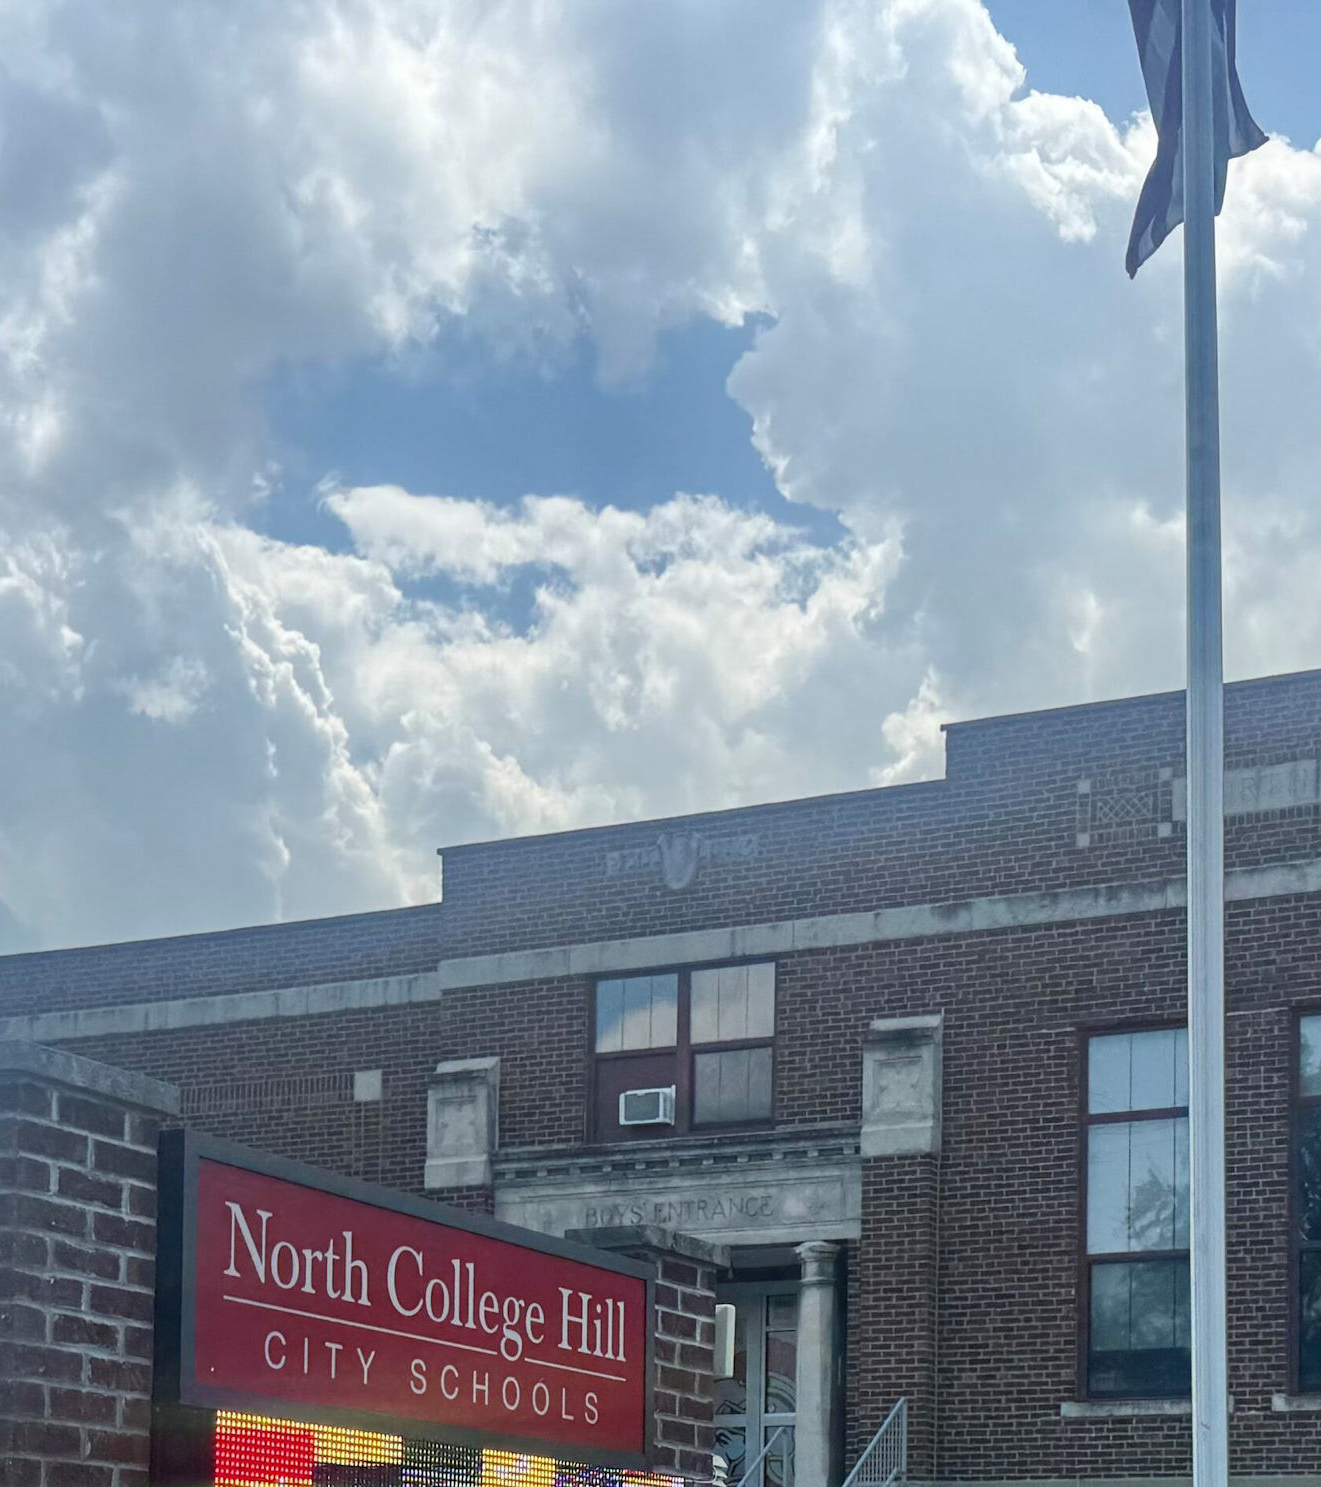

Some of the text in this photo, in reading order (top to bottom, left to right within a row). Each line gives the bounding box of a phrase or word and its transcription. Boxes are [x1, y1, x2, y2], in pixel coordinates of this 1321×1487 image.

[653, 1195, 774, 1224] ENTRANCE
[224, 1201, 627, 1362] North College Hill
[264, 1331, 599, 1424] CITY SCHOOLS
